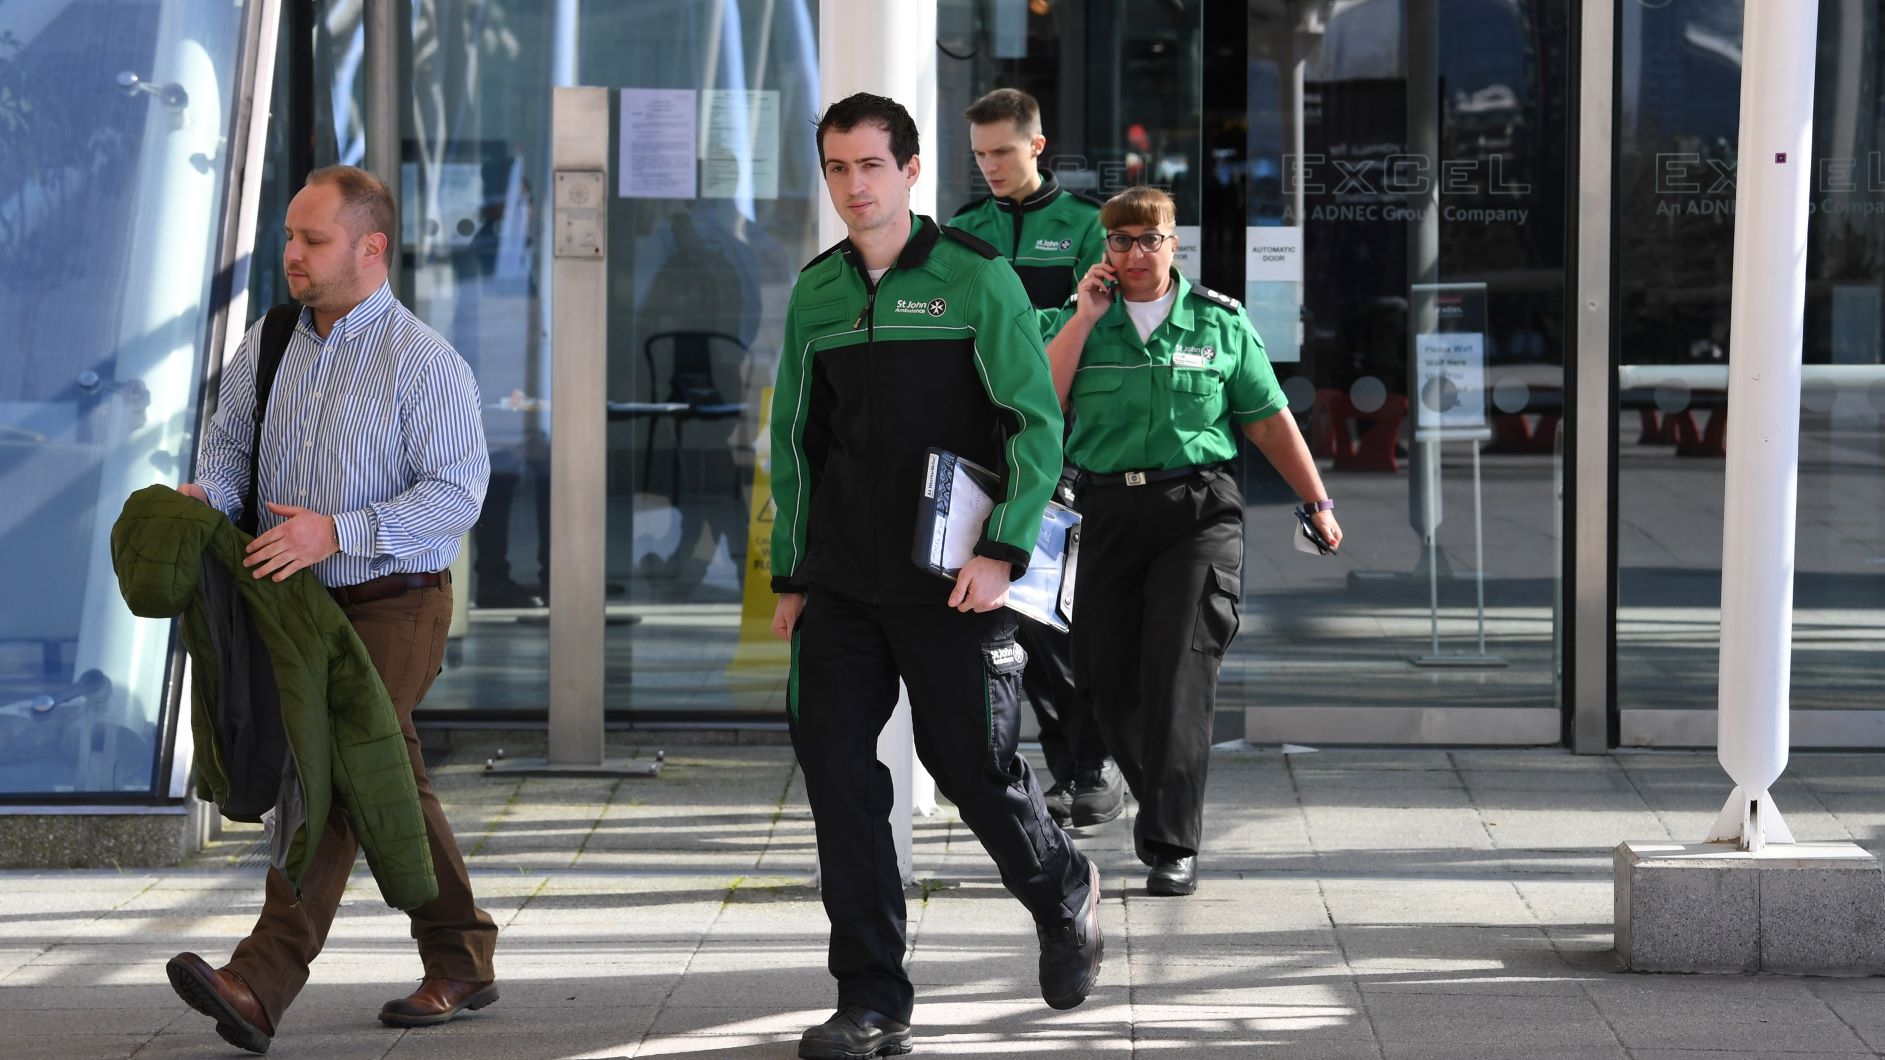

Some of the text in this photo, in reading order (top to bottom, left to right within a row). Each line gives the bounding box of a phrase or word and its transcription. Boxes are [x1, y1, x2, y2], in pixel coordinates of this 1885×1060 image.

[1311, 205, 1378, 221] ADNEC
[1444, 206, 1529, 225] Company
[1656, 199, 1681, 216] An
[1686, 199, 1736, 215] ADN
[1821, 199, 1885, 218] Compa
[896, 299, 927, 309] St John
